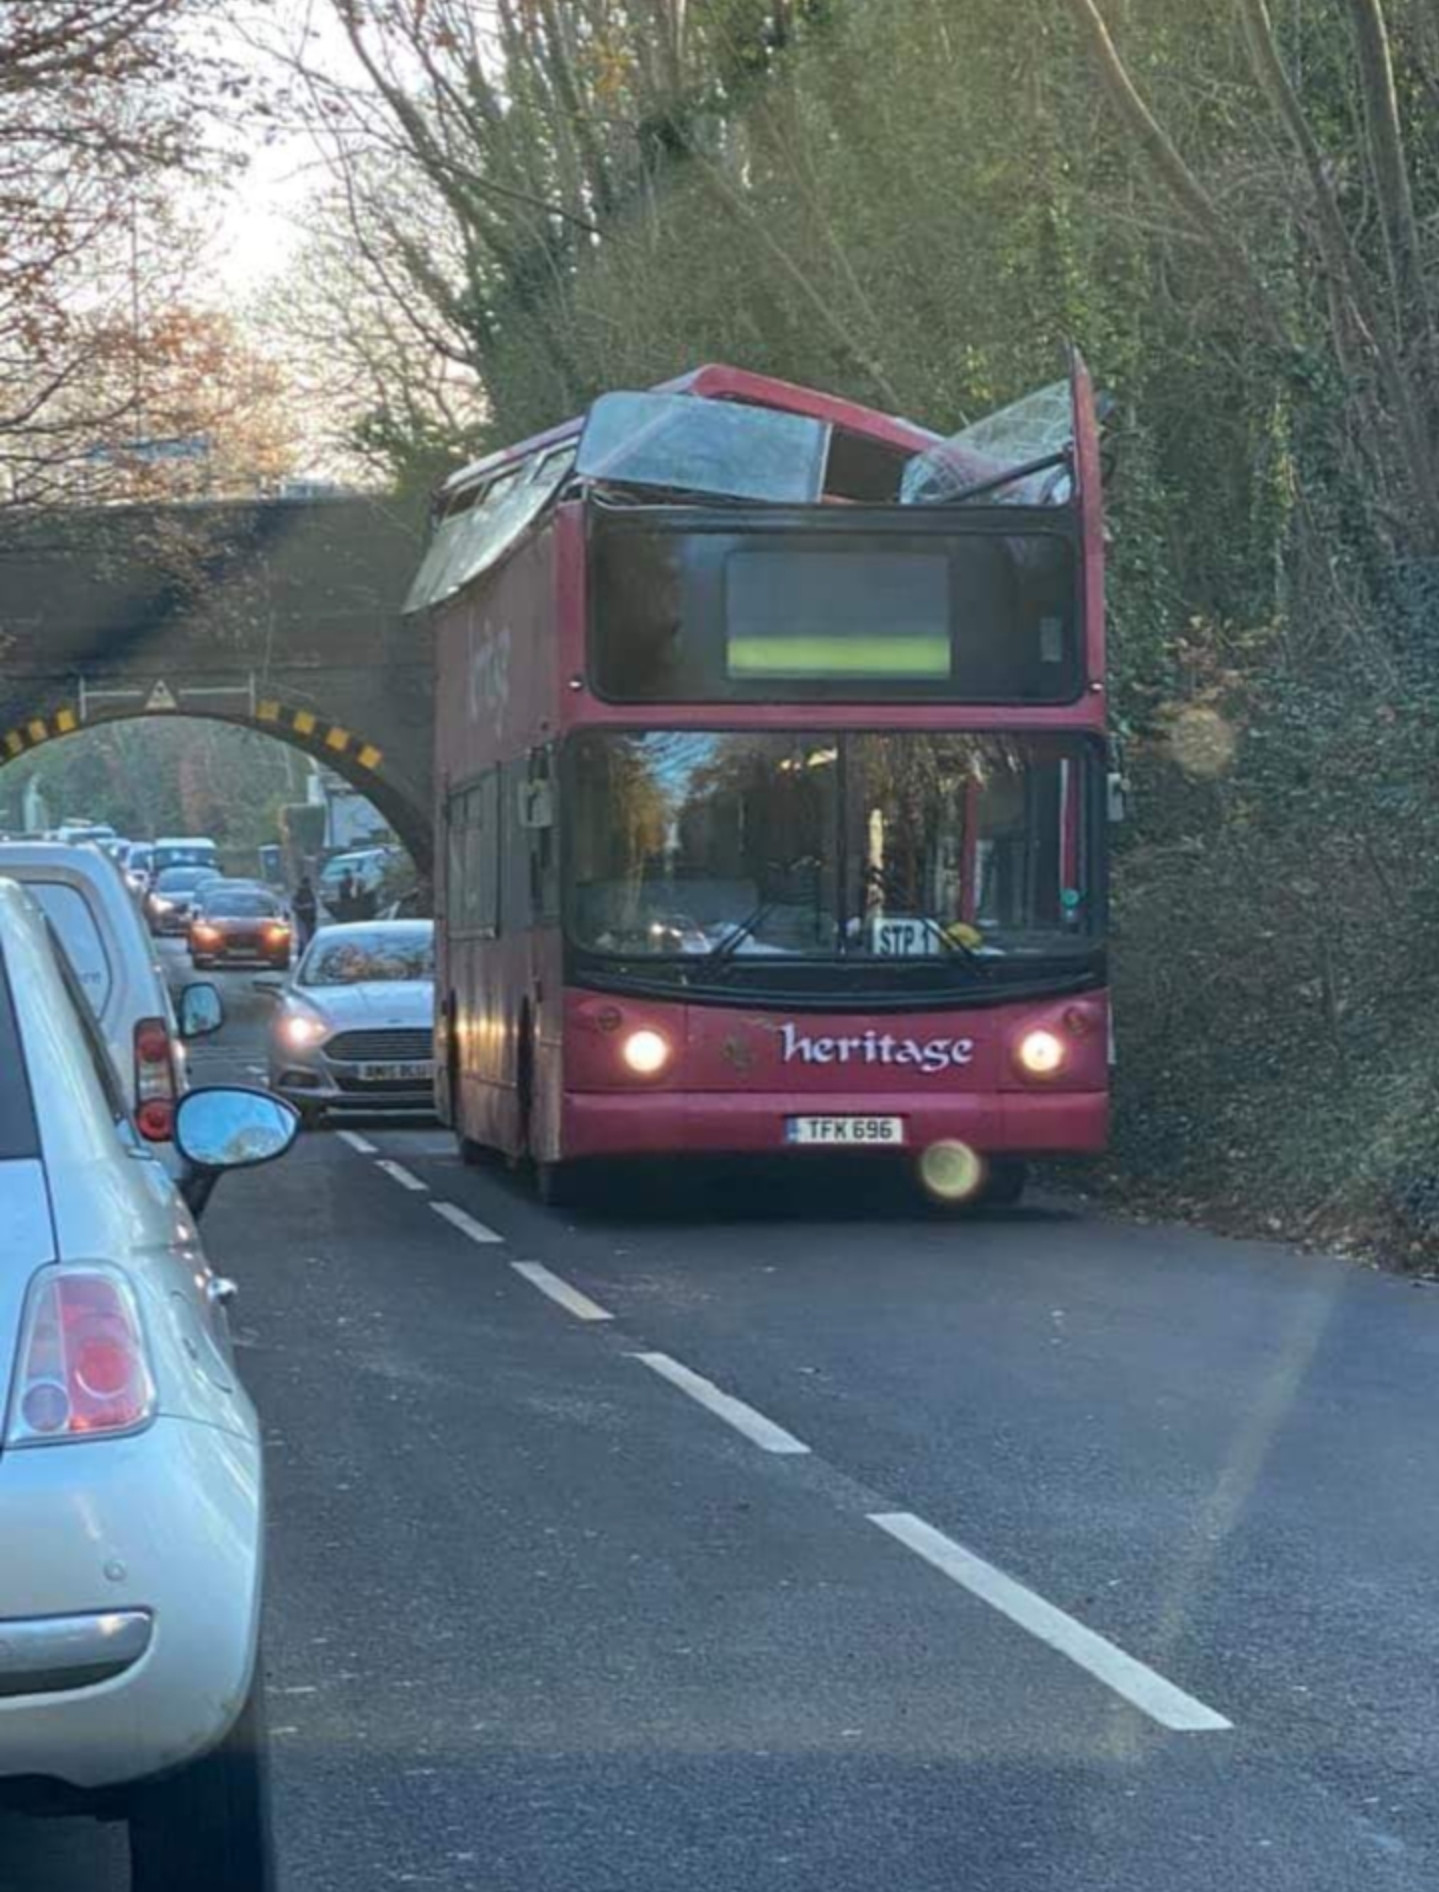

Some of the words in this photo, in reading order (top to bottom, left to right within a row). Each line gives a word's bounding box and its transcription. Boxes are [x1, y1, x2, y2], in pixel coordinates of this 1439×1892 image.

[880, 925, 914, 956] STP
[781, 1022, 974, 1072] heritage
[808, 1120, 847, 1140] TFK
[852, 1120, 893, 1140] 696
